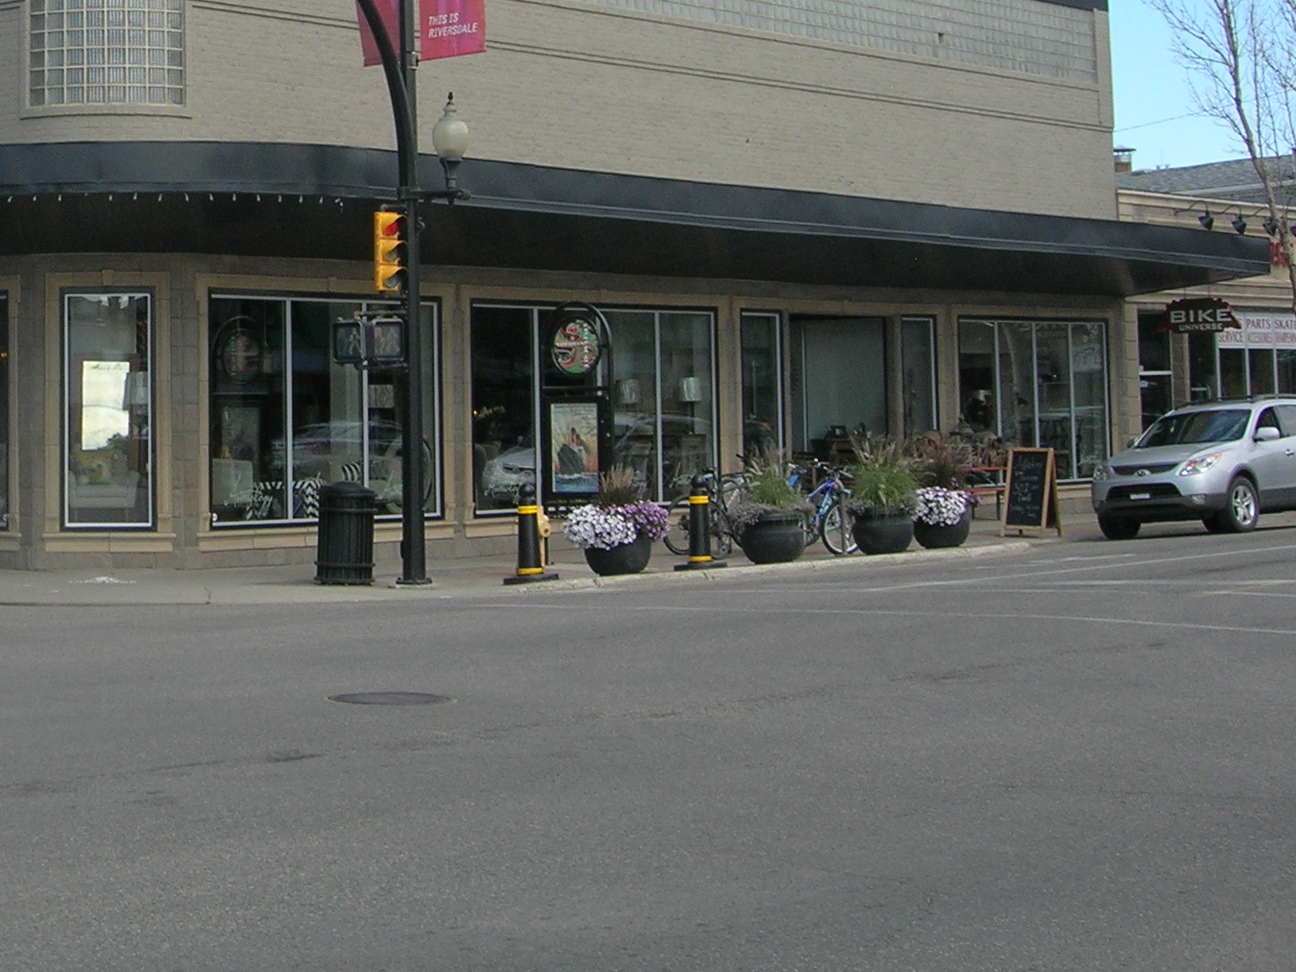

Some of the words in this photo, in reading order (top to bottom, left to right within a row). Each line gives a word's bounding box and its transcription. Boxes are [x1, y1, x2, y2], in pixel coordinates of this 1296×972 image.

[429, 14, 448, 26] THIS
[449, 12, 459, 23] IS
[428, 22, 478, 38] RIVERSDALE
[1170, 309, 1232, 323] BIKE
[1179, 322, 1223, 331] UNIVERSE
[1246, 318, 1271, 329] PARTS
[1218, 332, 1243, 342] SERVICE
